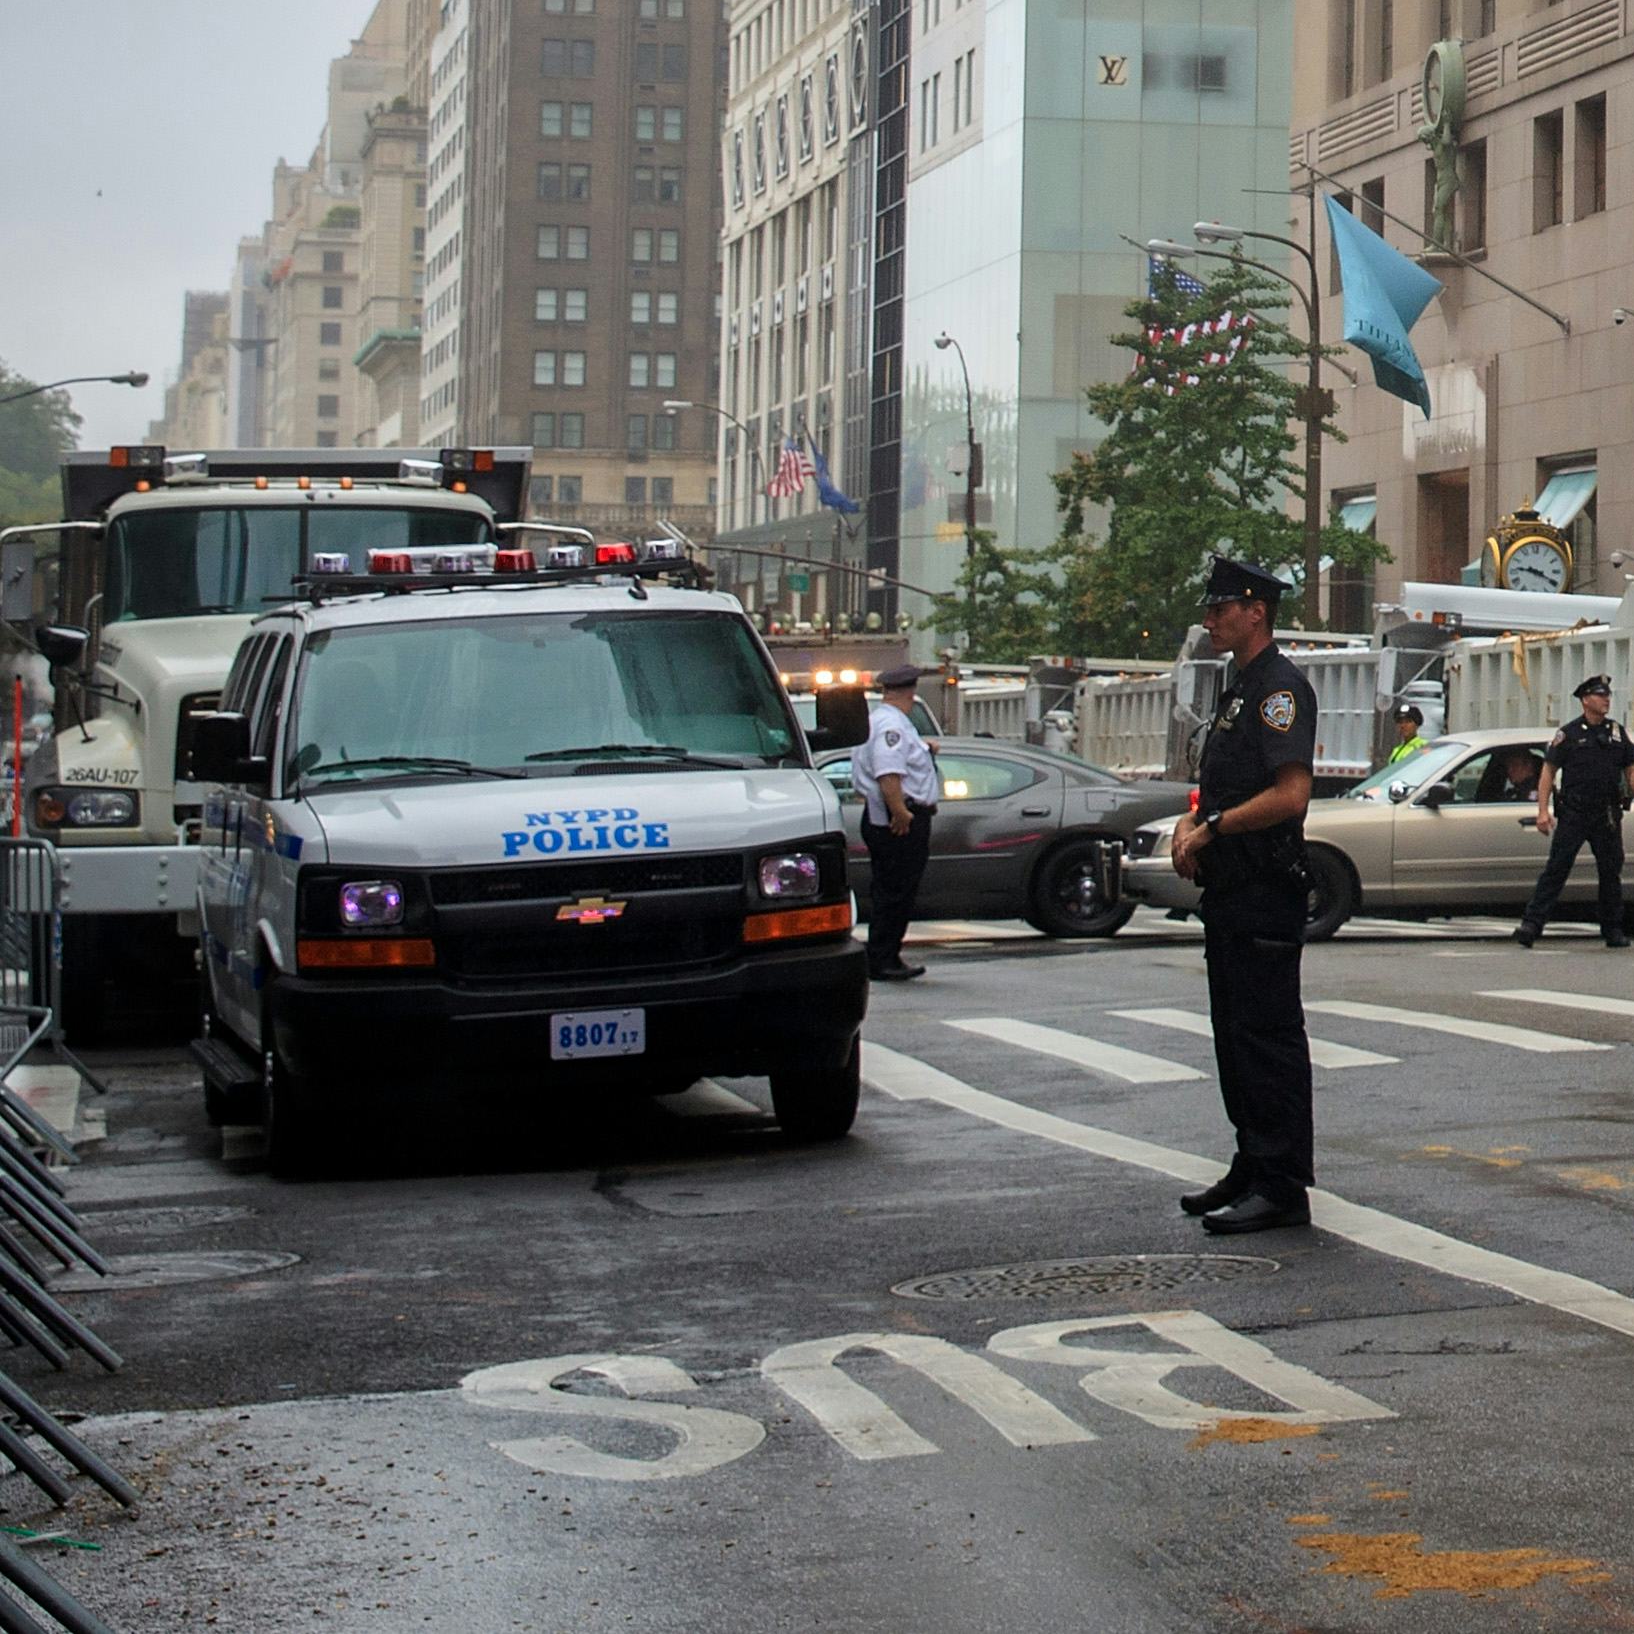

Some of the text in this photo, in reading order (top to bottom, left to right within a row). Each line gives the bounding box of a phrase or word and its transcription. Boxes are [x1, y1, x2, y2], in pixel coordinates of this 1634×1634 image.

[65, 766, 140, 785] 26AU-107
[524, 807, 640, 827] NYPD
[502, 822, 670, 858] POLICE
[560, 1022, 619, 1048] 8807
[460, 1308, 1402, 1482] BUS
